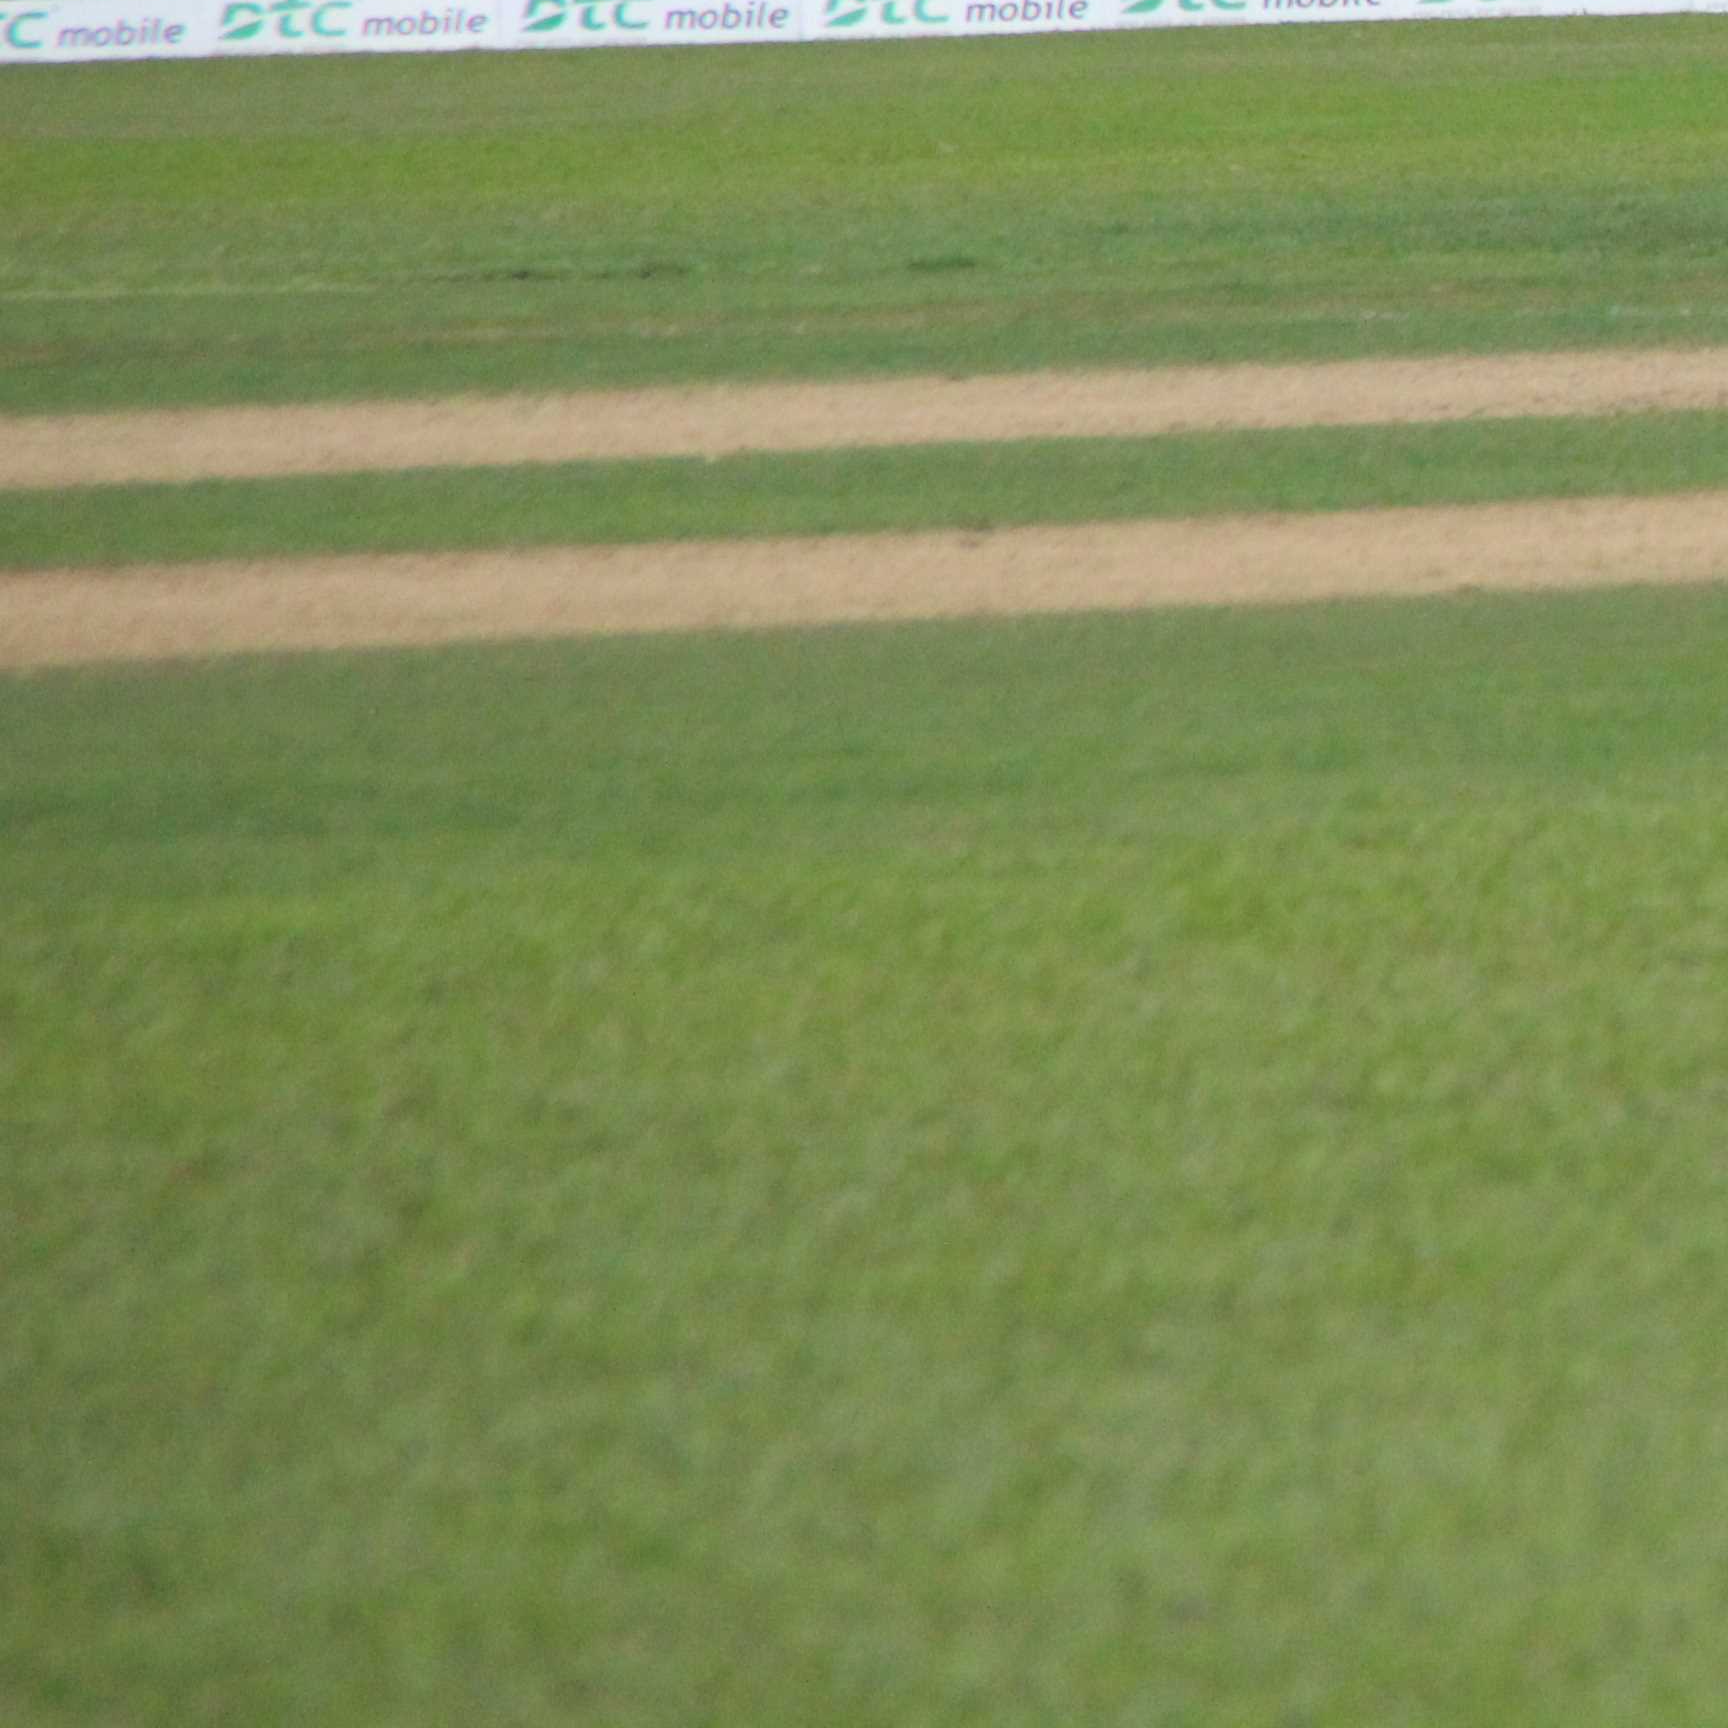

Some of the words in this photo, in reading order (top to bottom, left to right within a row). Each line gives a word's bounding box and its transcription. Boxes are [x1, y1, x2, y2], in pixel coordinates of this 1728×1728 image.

[362, 7, 489, 38] mobile
[664, 1, 790, 31] mobile
[57, 17, 187, 48] mobile
